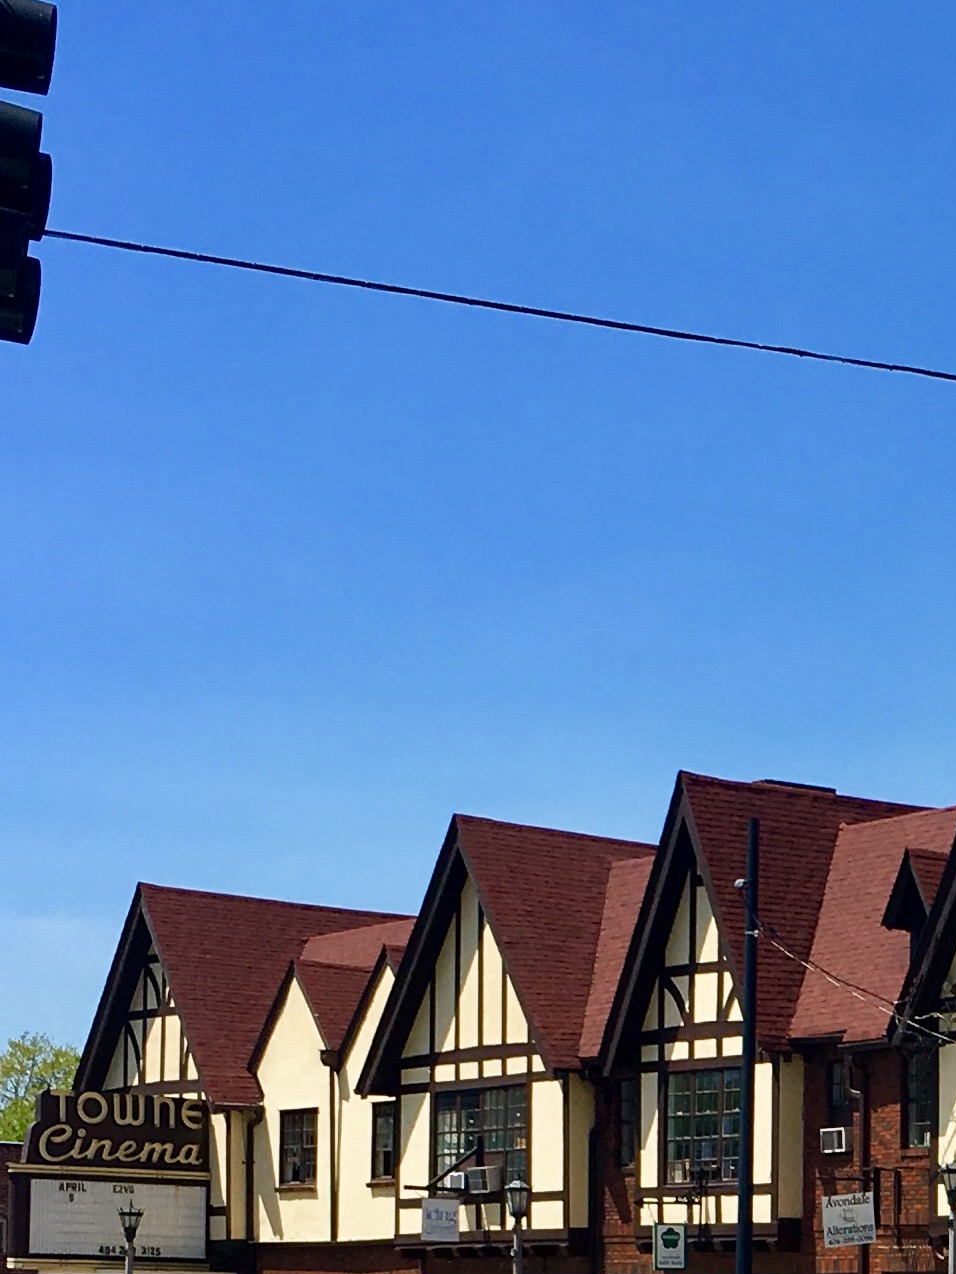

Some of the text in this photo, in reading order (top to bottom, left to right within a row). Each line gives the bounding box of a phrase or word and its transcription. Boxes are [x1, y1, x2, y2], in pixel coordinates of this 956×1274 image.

[38, 1123, 203, 1165] Cinema
[59, 1182, 87, 1193] APRIL
[825, 1192, 871, 1208] Avondale
[827, 1223, 874, 1237] Alterations
